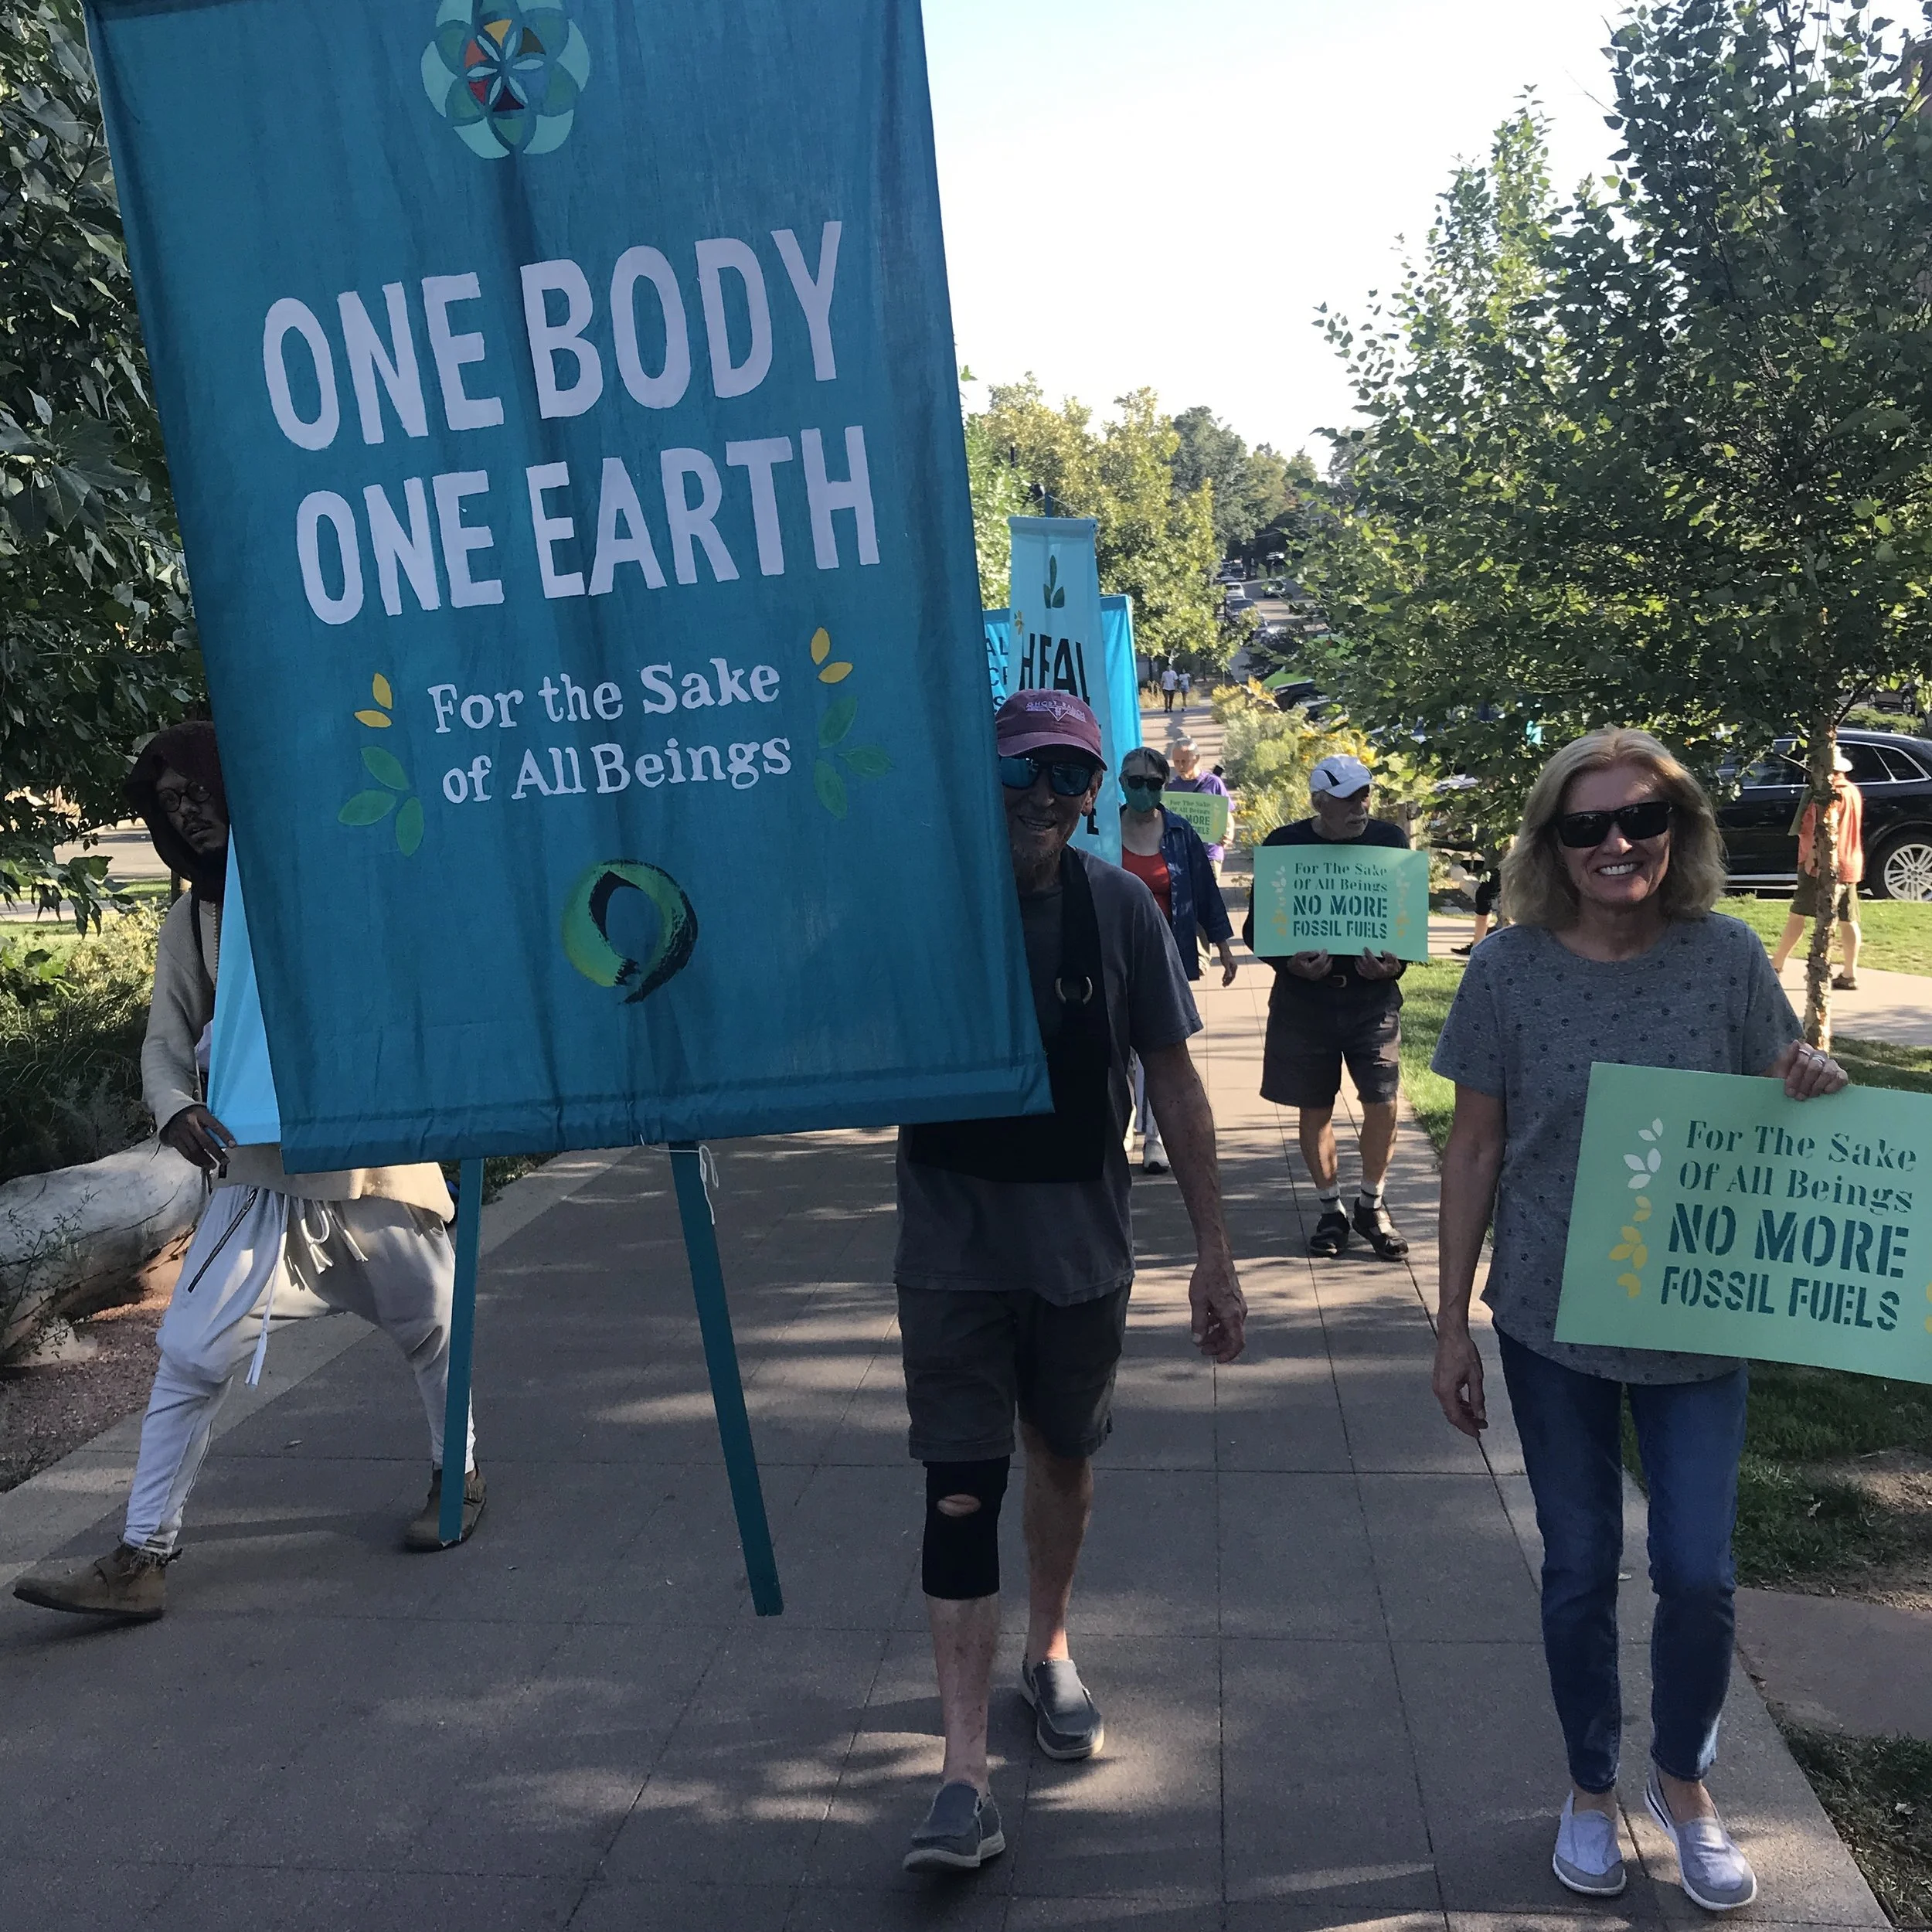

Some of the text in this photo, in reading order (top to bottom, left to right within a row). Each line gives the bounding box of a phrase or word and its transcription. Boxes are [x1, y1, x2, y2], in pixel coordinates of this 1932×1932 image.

[263, 221, 842, 451] ONE BODY
[296, 426, 880, 624] ONE EARTH
[427, 658, 781, 733] For the Sake
[441, 736, 792, 804] of All Beings
[1185, 815, 1210, 826] MORE
[1294, 878, 1388, 893] Of All Beings
[1295, 862, 1387, 876] For The Sake
[1293, 895, 1388, 918] NO MORE
[1293, 920, 1387, 940] FOSSIL FUELS
[1686, 1120, 1917, 1172] For The Sake
[1679, 1161, 1913, 1216] Of All Beings
[1668, 1202, 1910, 1279] NO MORE
[1661, 1266, 1900, 1331] FOSSIL FUELS
